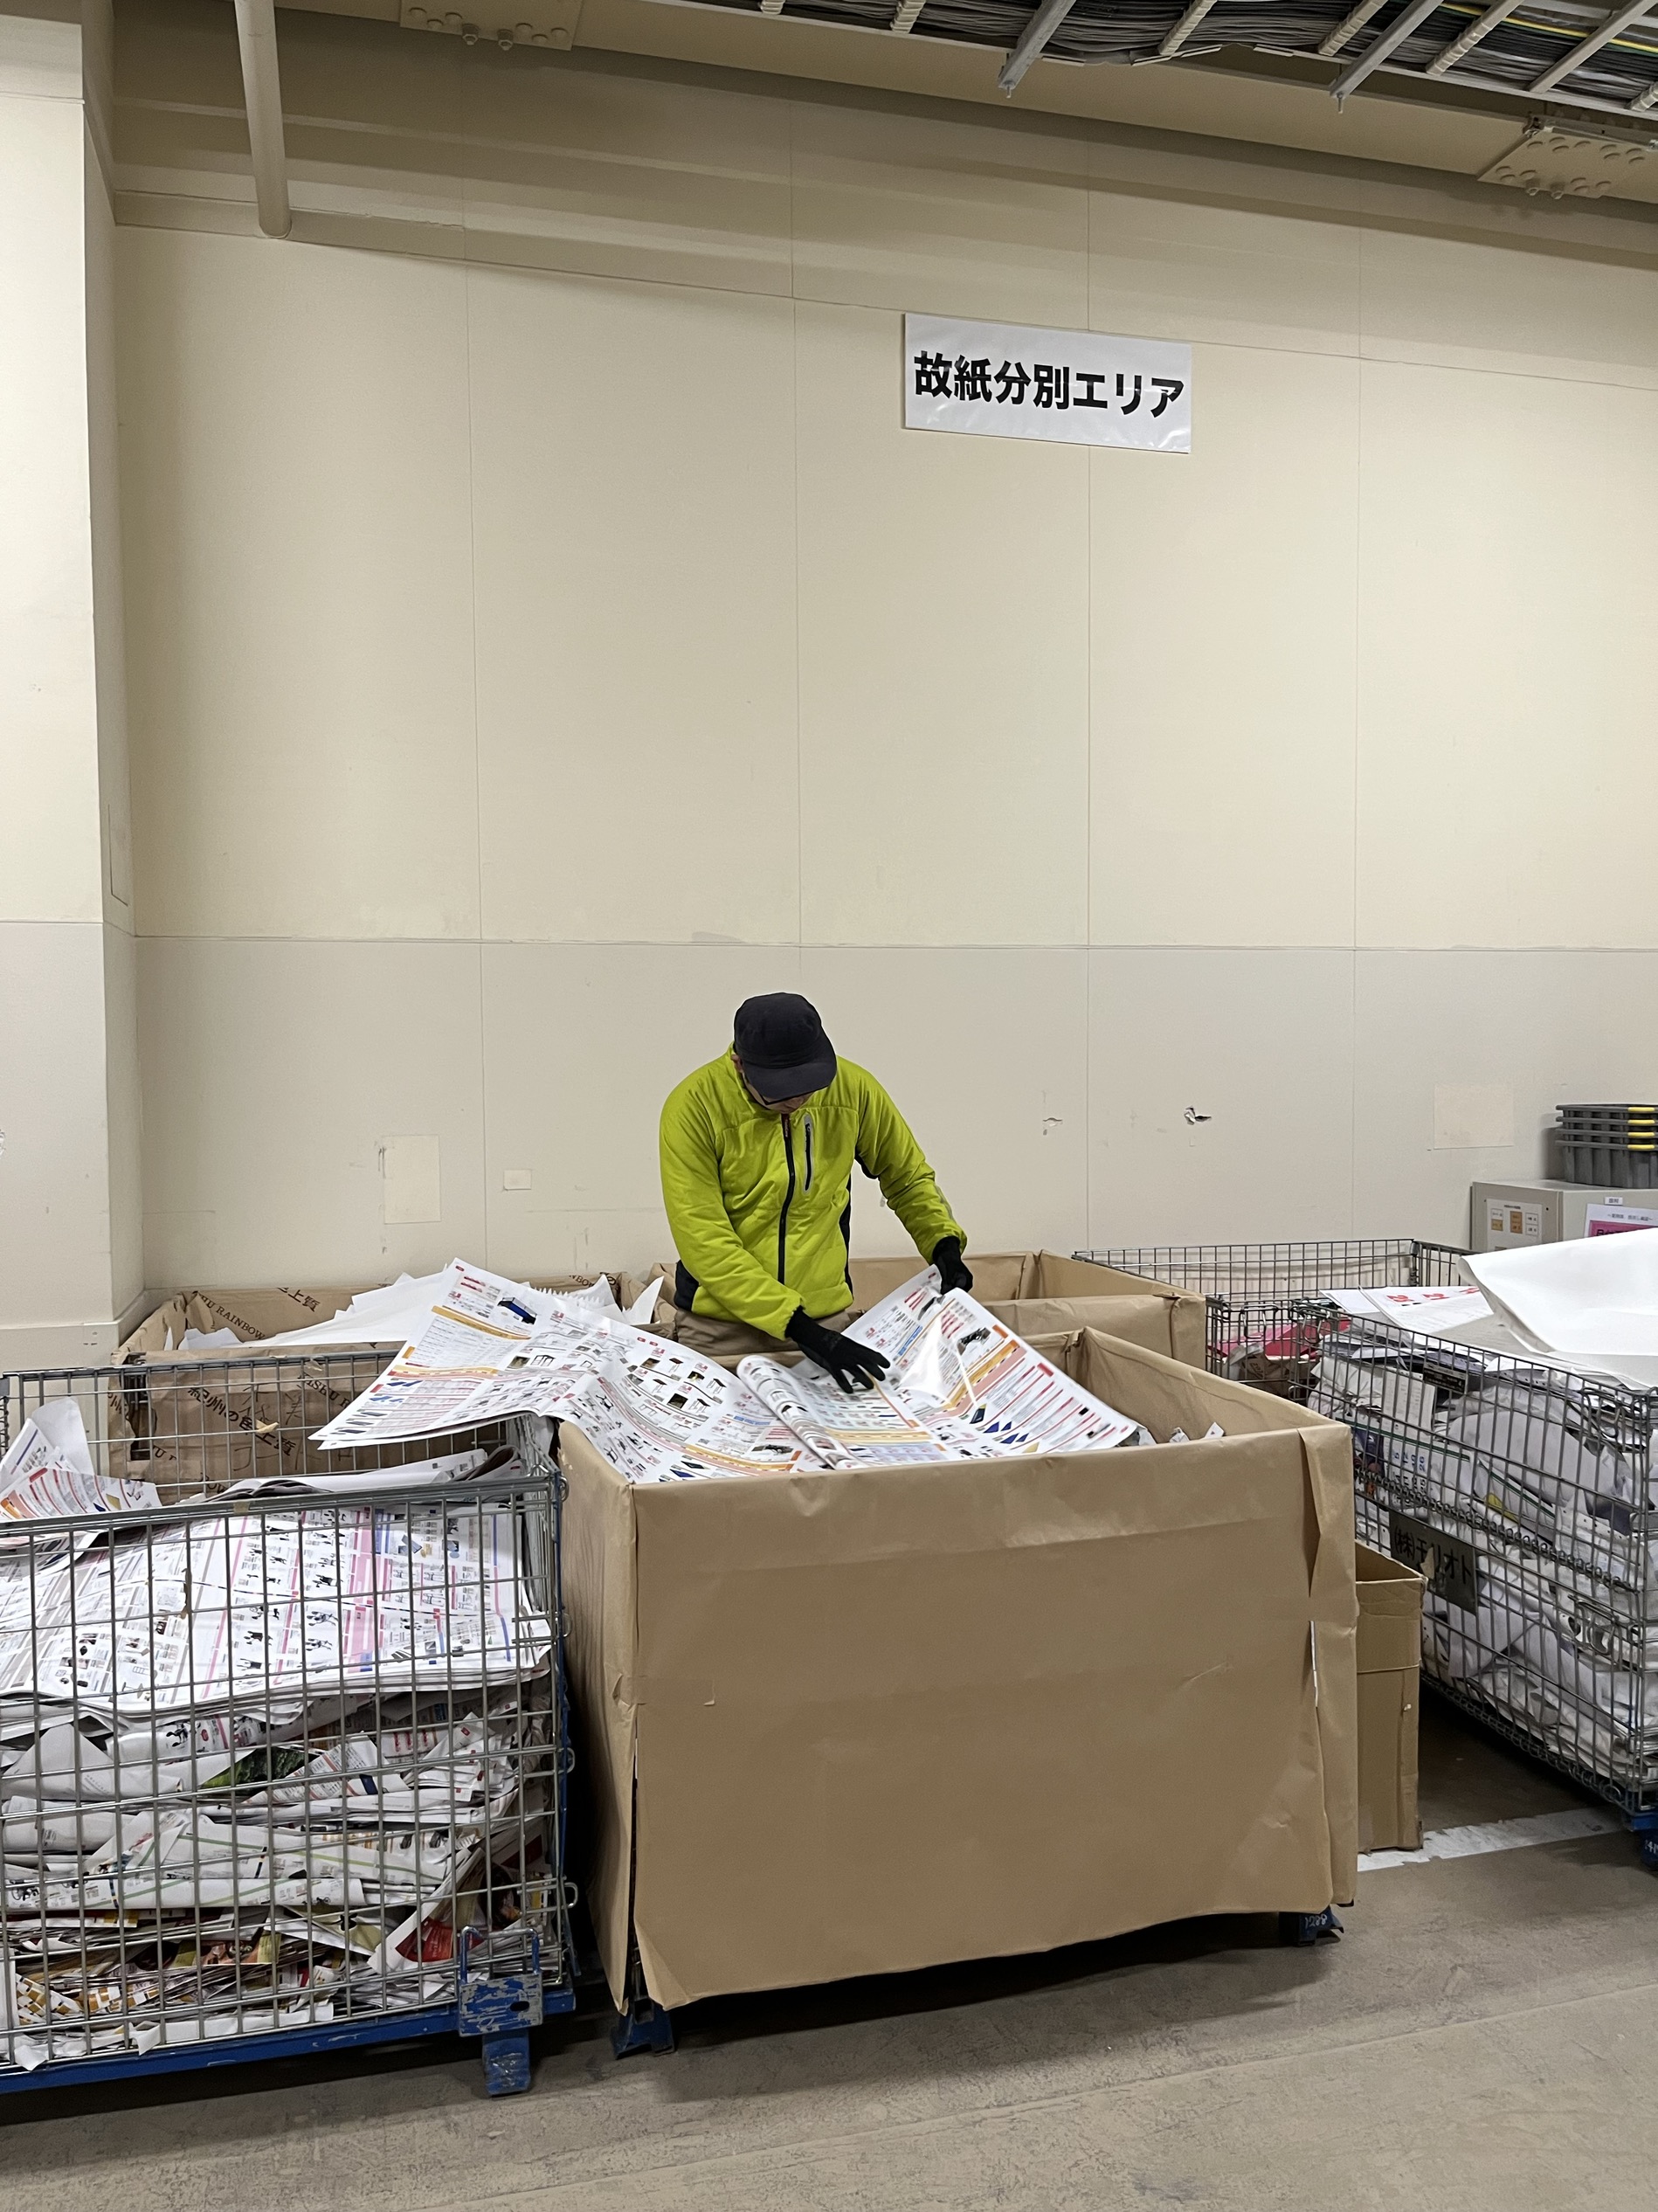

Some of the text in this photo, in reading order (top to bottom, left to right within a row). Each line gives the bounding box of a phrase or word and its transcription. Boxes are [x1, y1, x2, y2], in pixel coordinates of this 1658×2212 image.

[914, 350, 1185, 418] 故紙分別エリア
[216, 1305, 266, 1340] RAINBOW
